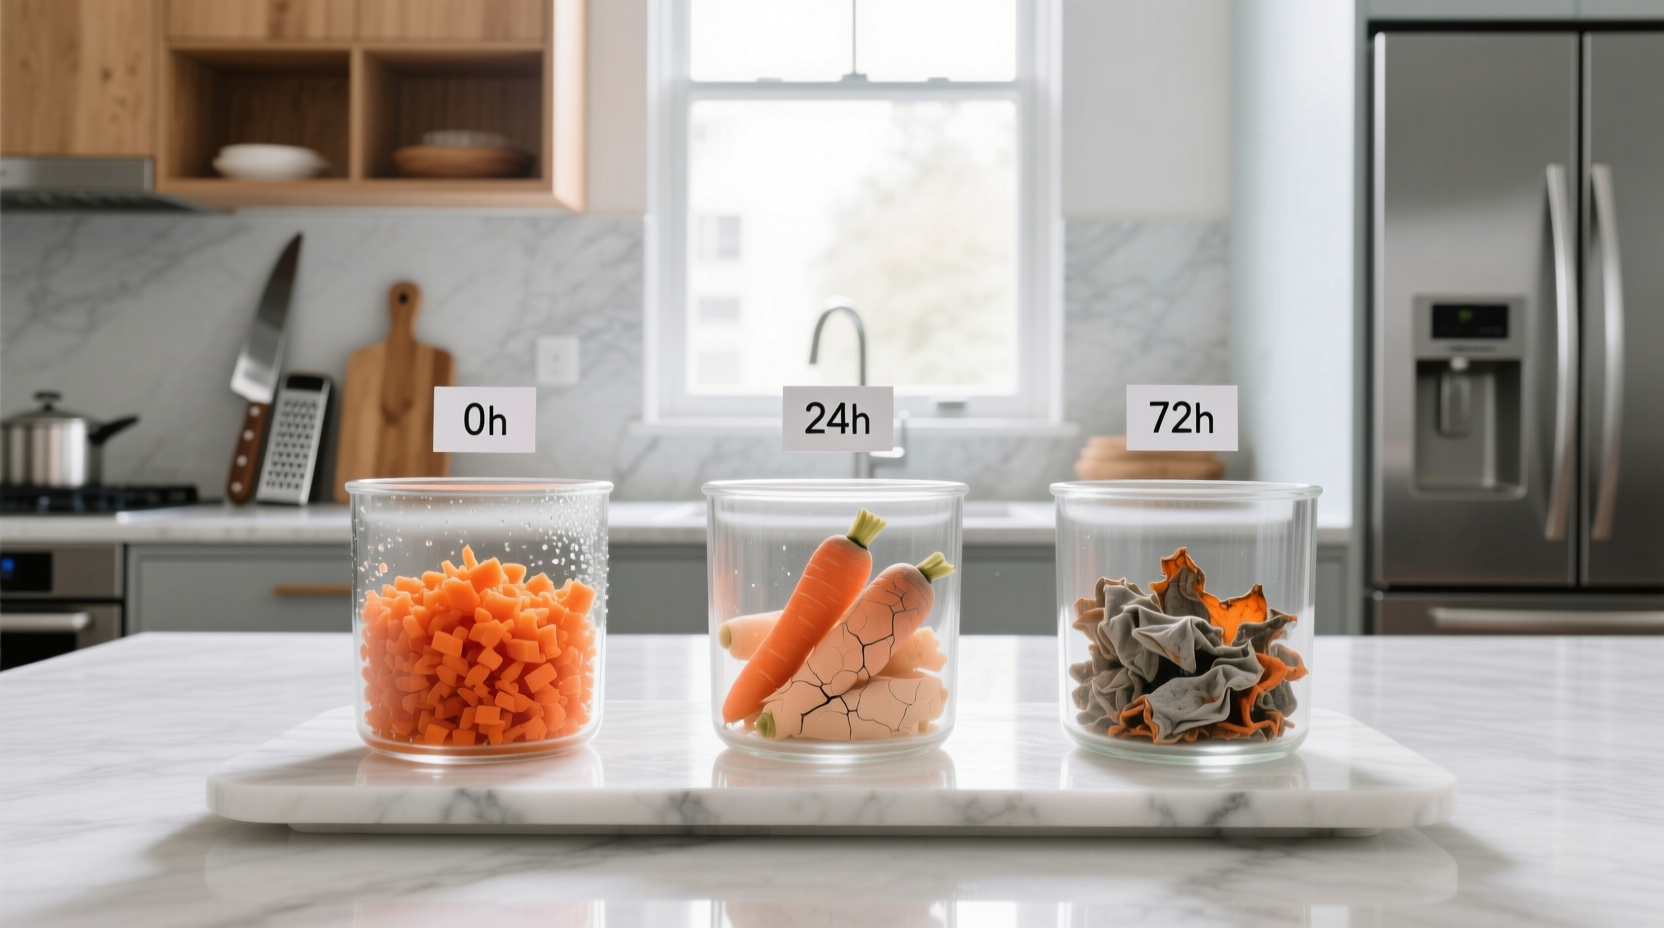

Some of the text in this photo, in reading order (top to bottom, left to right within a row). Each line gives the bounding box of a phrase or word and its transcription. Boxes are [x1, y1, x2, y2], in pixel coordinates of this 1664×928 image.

[463, 402, 507, 436] 0h
[804, 401, 870, 435] 24h
[1149, 400, 1214, 434] 72h
